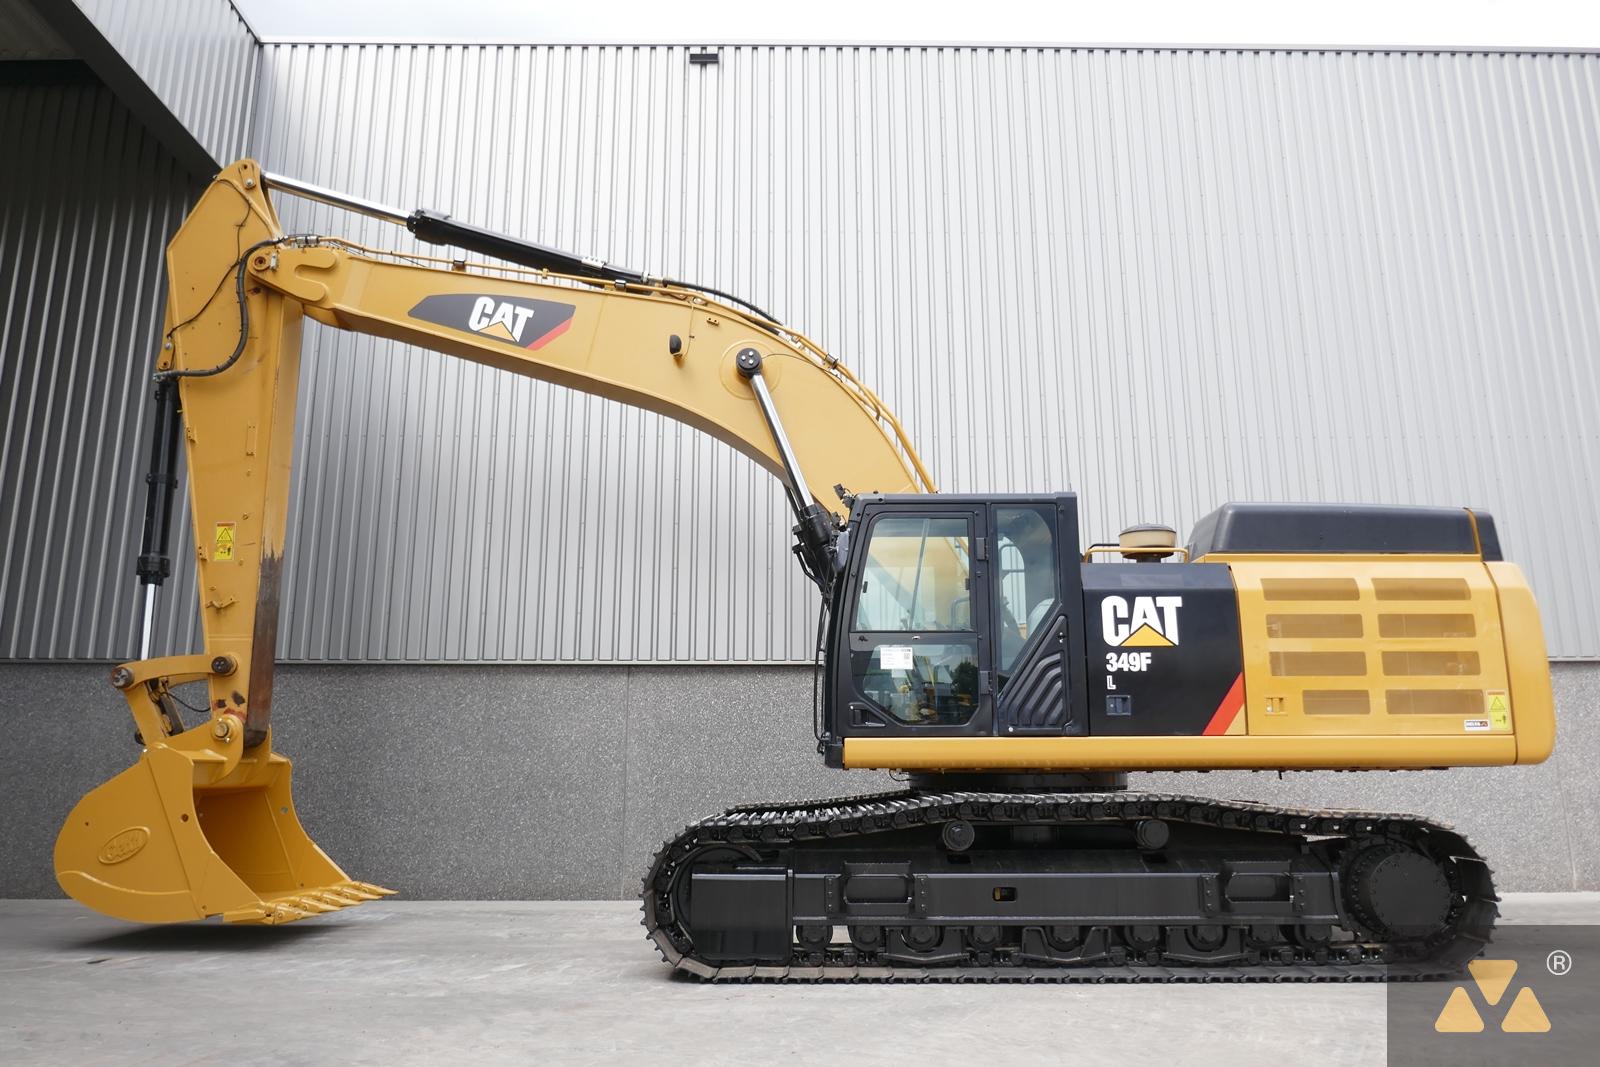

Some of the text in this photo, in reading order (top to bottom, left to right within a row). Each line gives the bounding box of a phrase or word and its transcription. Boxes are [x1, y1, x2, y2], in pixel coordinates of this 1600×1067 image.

[468, 296, 535, 343] CAT
[1101, 595, 1183, 646] CAT
[1106, 652, 1152, 672] 349F
[1106, 675, 1117, 690] L
